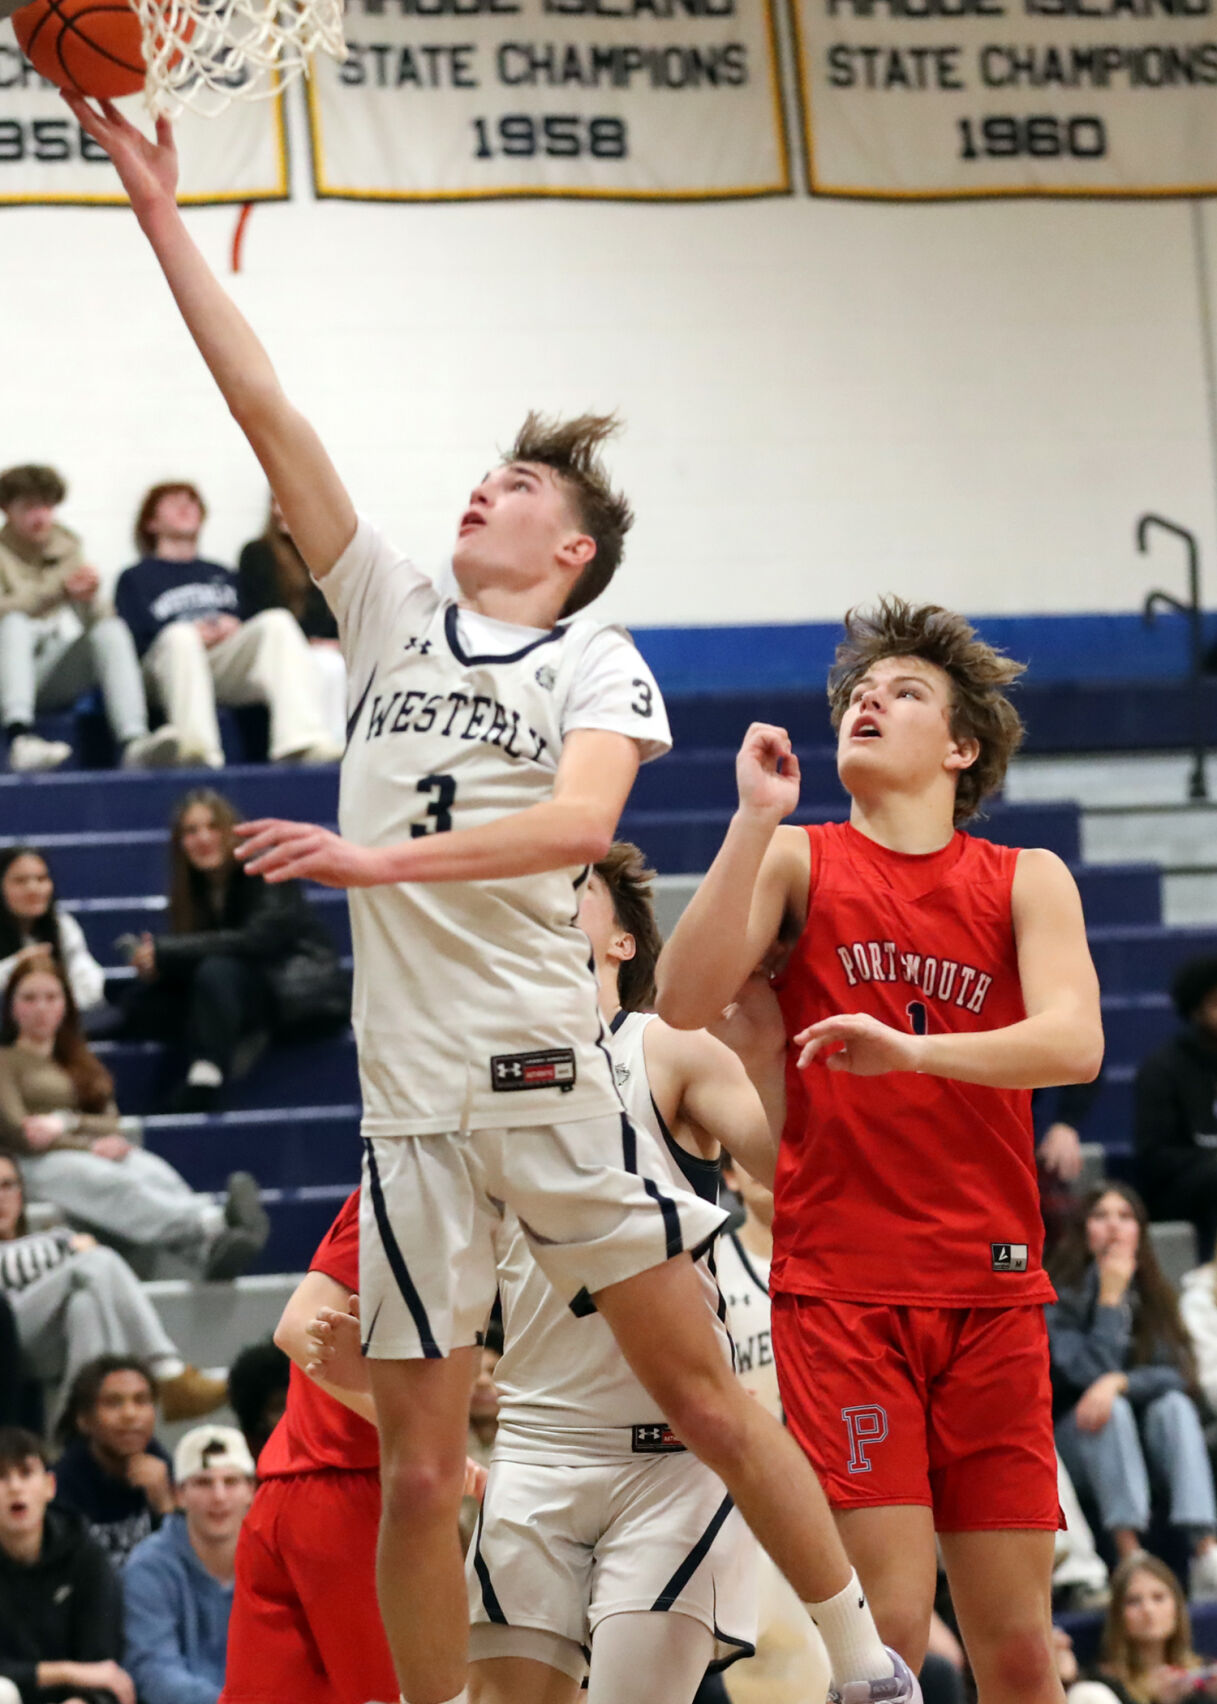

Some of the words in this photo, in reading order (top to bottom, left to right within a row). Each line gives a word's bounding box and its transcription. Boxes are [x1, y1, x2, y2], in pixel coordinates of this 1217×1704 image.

[341, 43, 477, 87] STATE
[498, 43, 746, 88] CHAMPIONS
[828, 45, 964, 90] STATE
[979, 45, 1217, 88] CHAMPIONS
[473, 115, 628, 159] 1958
[958, 116, 1106, 159] 1960
[631, 678, 653, 718] 3
[366, 691, 548, 762] WESTERLY
[410, 774, 457, 839] 3
[841, 1403, 889, 1474] P
